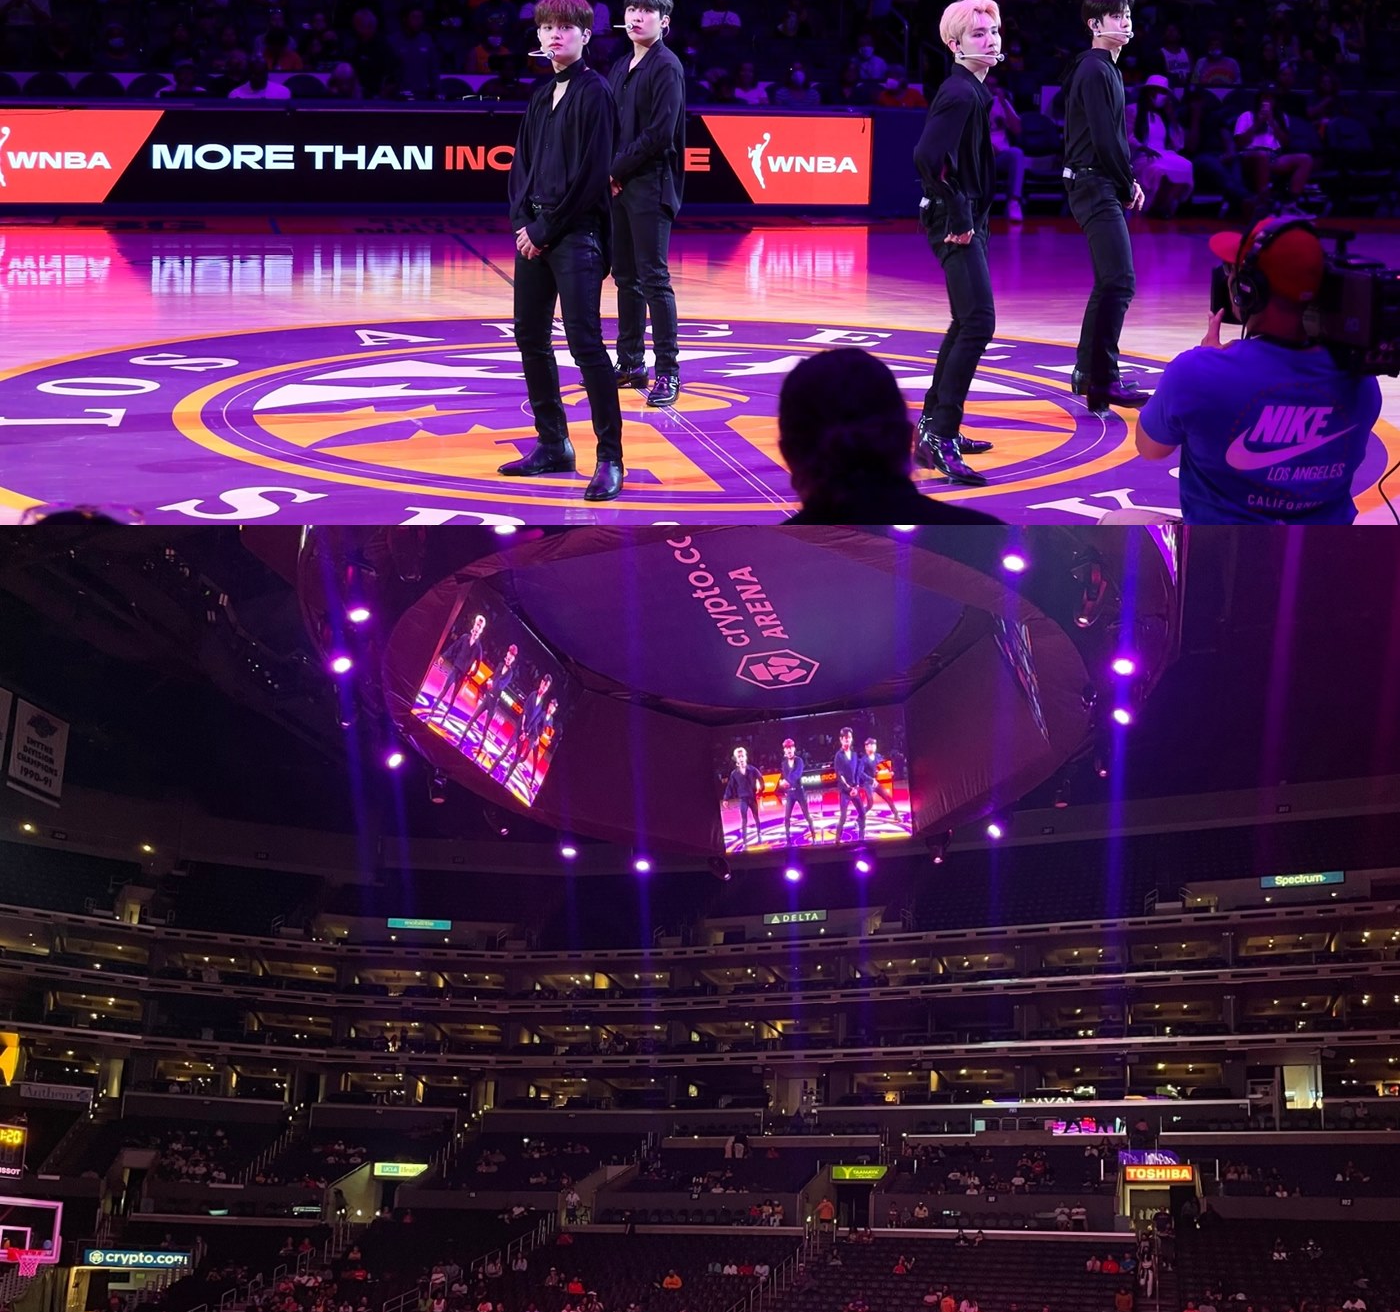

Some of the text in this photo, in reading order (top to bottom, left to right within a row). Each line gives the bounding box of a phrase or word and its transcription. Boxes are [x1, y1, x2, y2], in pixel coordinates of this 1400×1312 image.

[7, 151, 112, 169] WNBA
[152, 143, 295, 170] MORE
[305, 145, 433, 171] THAN
[768, 156, 858, 173] WNBA
[1248, 405, 1334, 444] NIKE
[1267, 462, 1345, 481] LOS ANGELES
[728, 566, 789, 639] ARENA
[1275, 874, 1323, 886] Spectrum
[783, 912, 818, 922] DELTA
[1127, 1168, 1190, 1179] TOSHIBA
